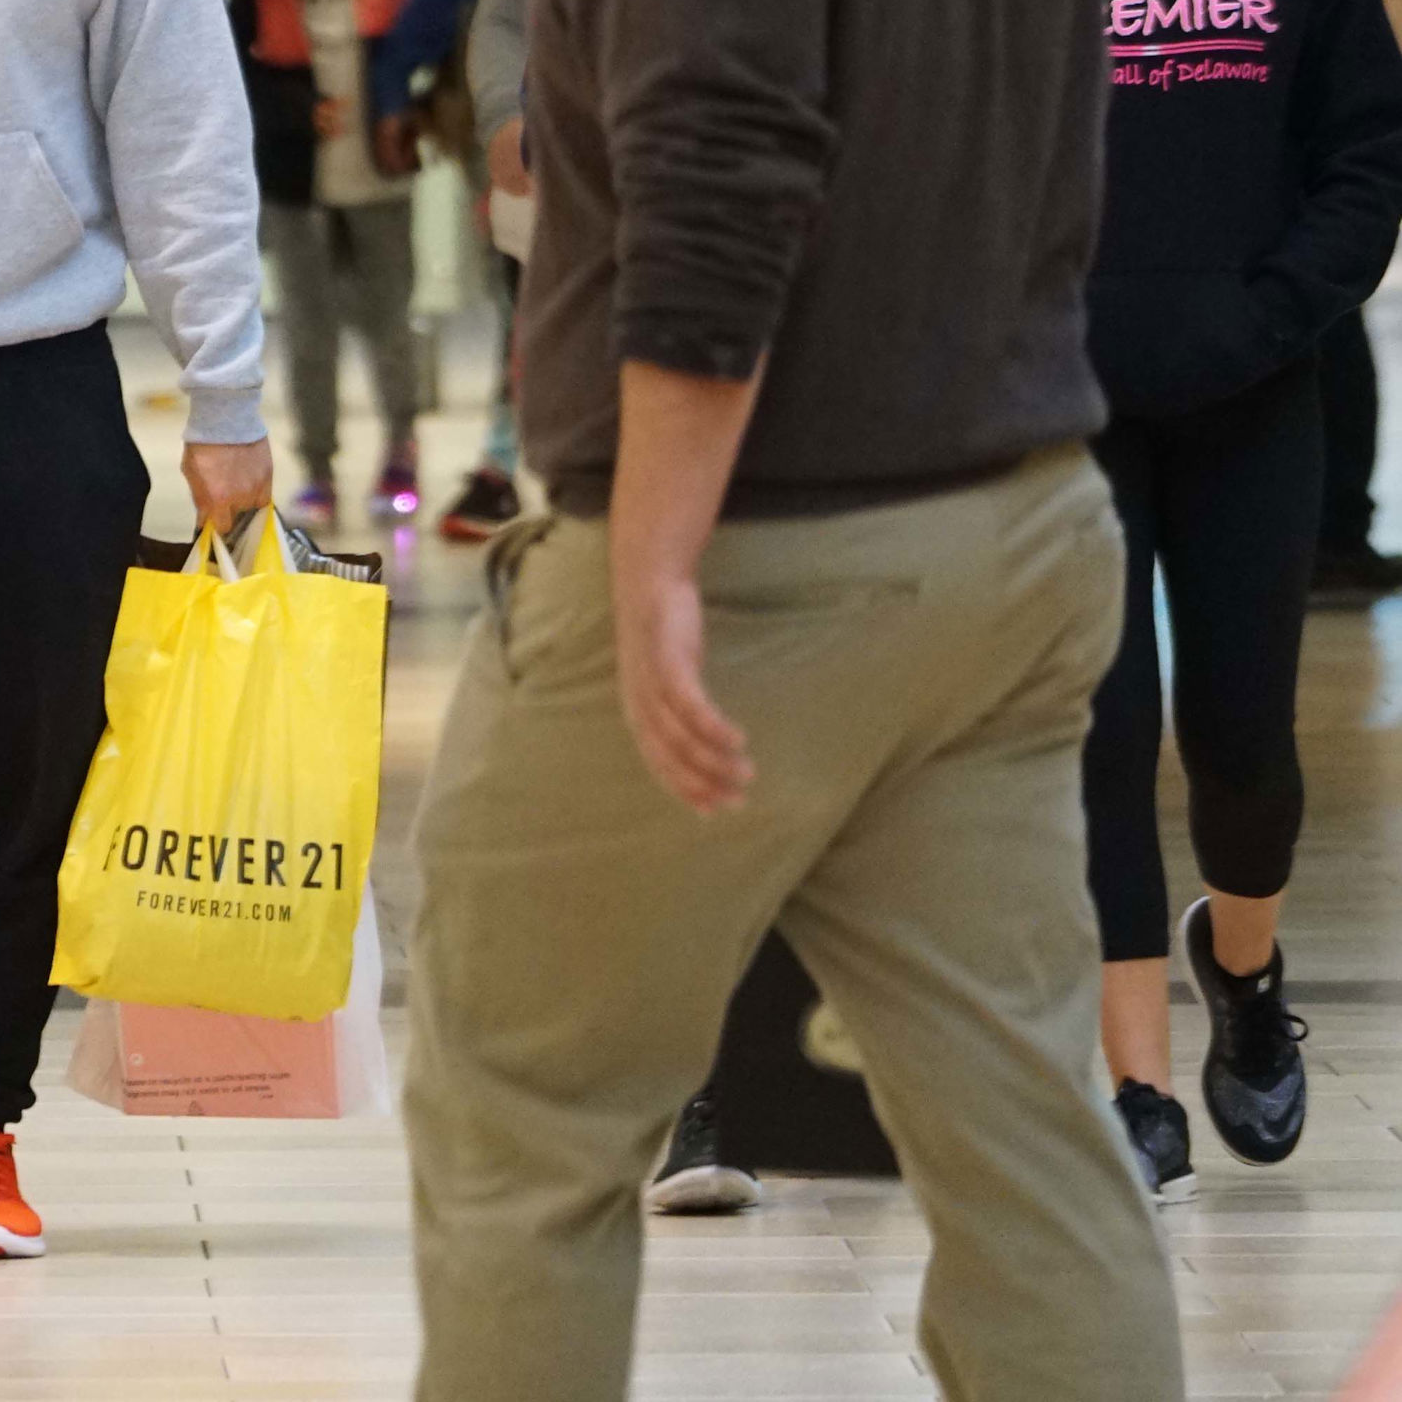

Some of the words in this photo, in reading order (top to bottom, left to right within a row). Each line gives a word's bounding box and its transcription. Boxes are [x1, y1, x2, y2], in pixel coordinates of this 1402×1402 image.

[1110, 64, 1145, 85] all
[1148, 57, 1175, 92] of
[1176, 58, 1270, 83] Delaware
[136, 890, 292, 924] FOREVER21.COM
